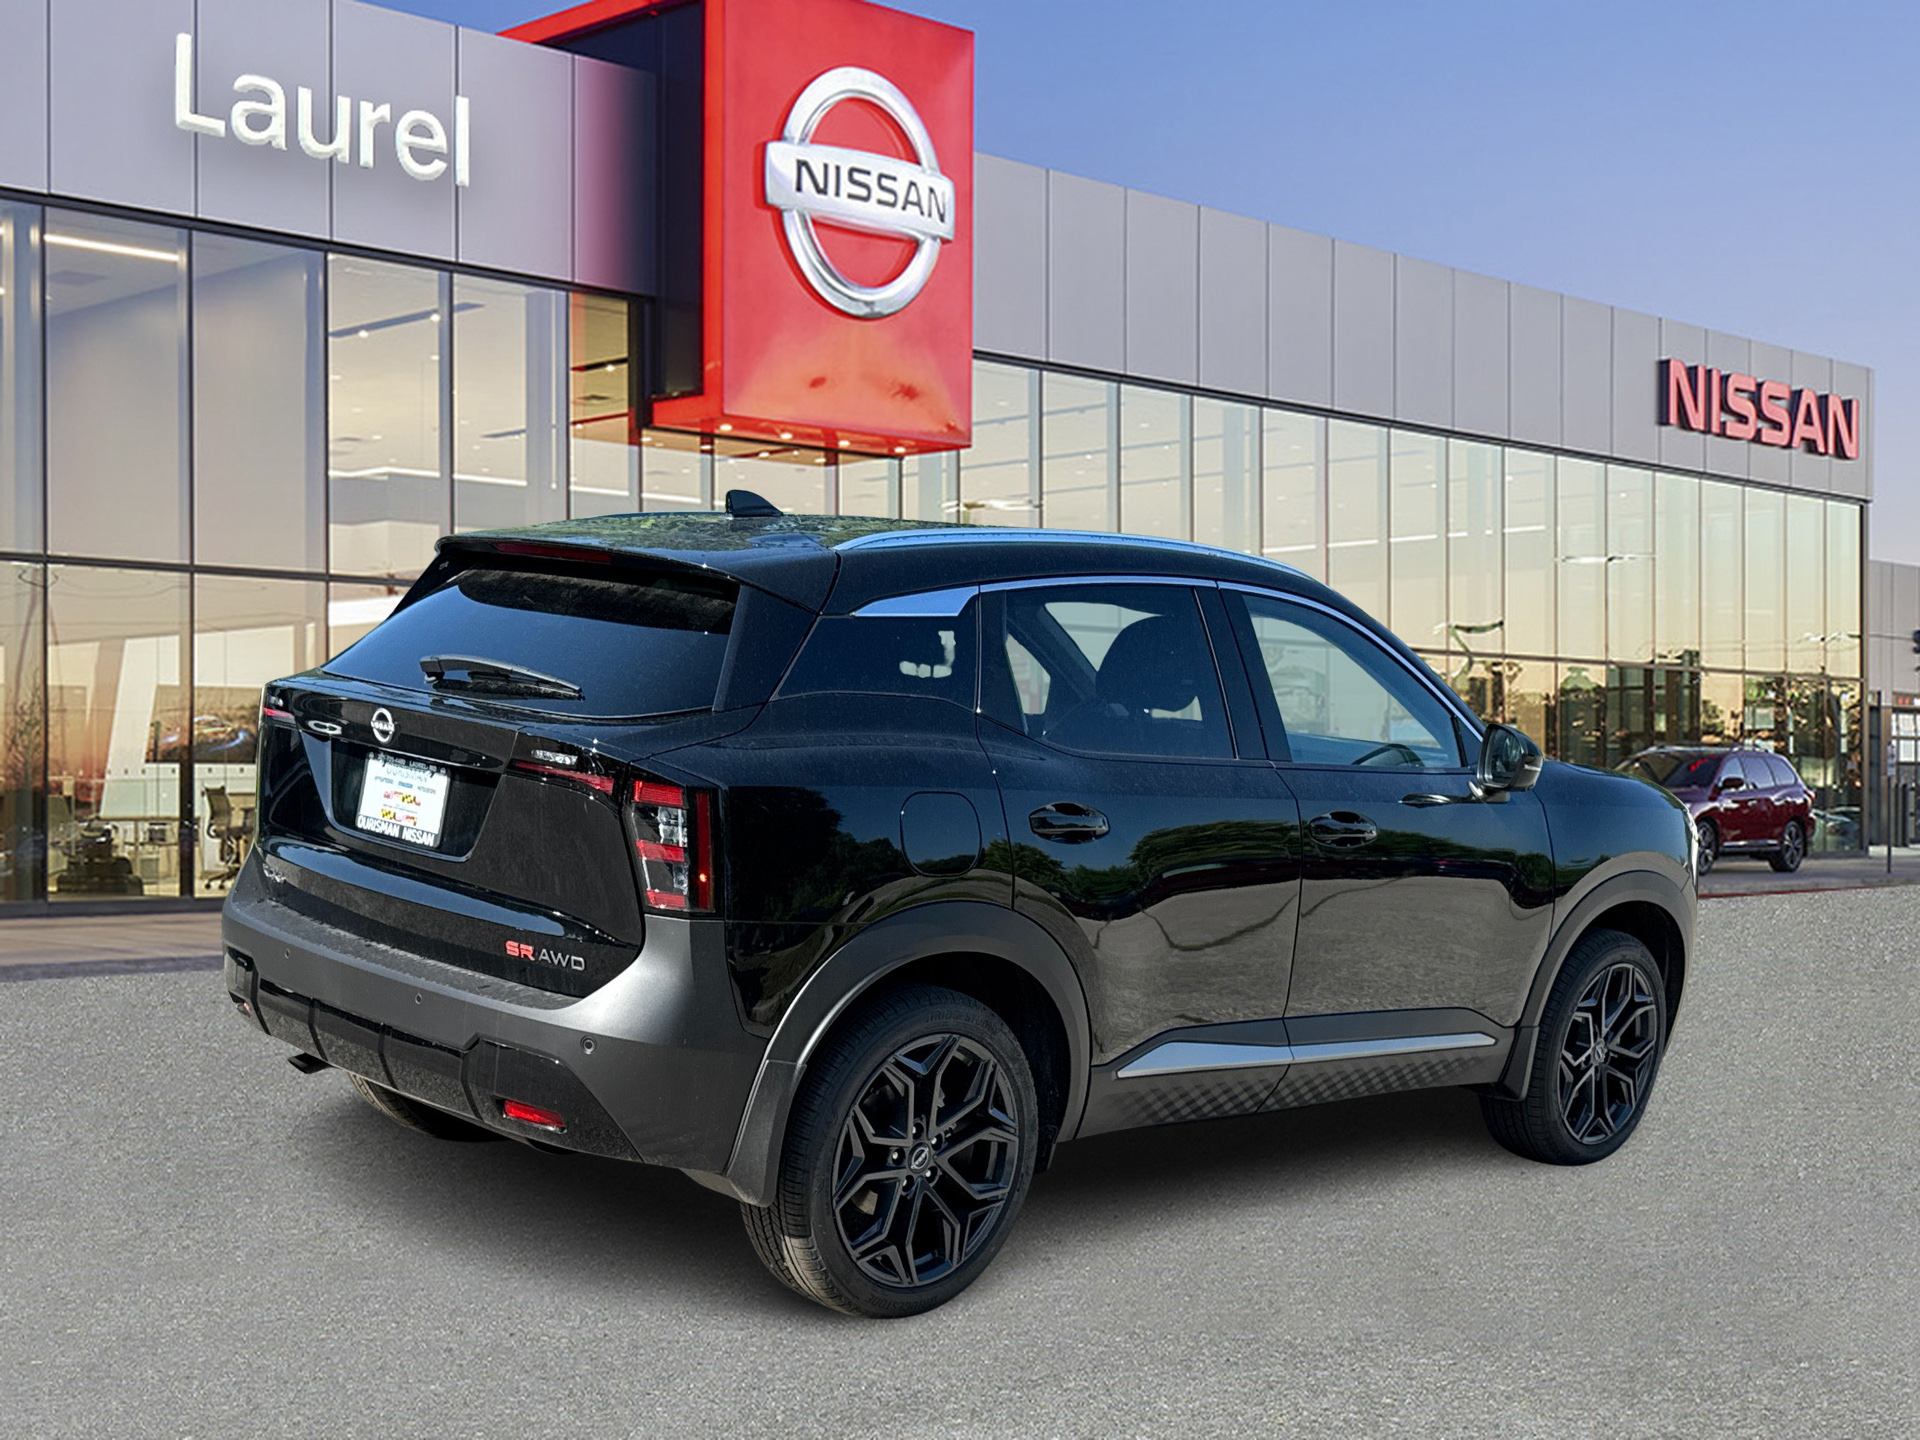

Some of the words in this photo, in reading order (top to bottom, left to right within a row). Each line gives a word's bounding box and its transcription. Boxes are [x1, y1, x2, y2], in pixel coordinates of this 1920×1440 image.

[175, 33, 470, 188] Laurel
[794, 158, 947, 224] NISSAN
[1658, 358, 1860, 460] NISSAN
[357, 815, 400, 838] OURISMAN
[402, 828, 435, 847] NISSAN
[505, 940, 535, 961] SR
[538, 948, 585, 971] AWD
